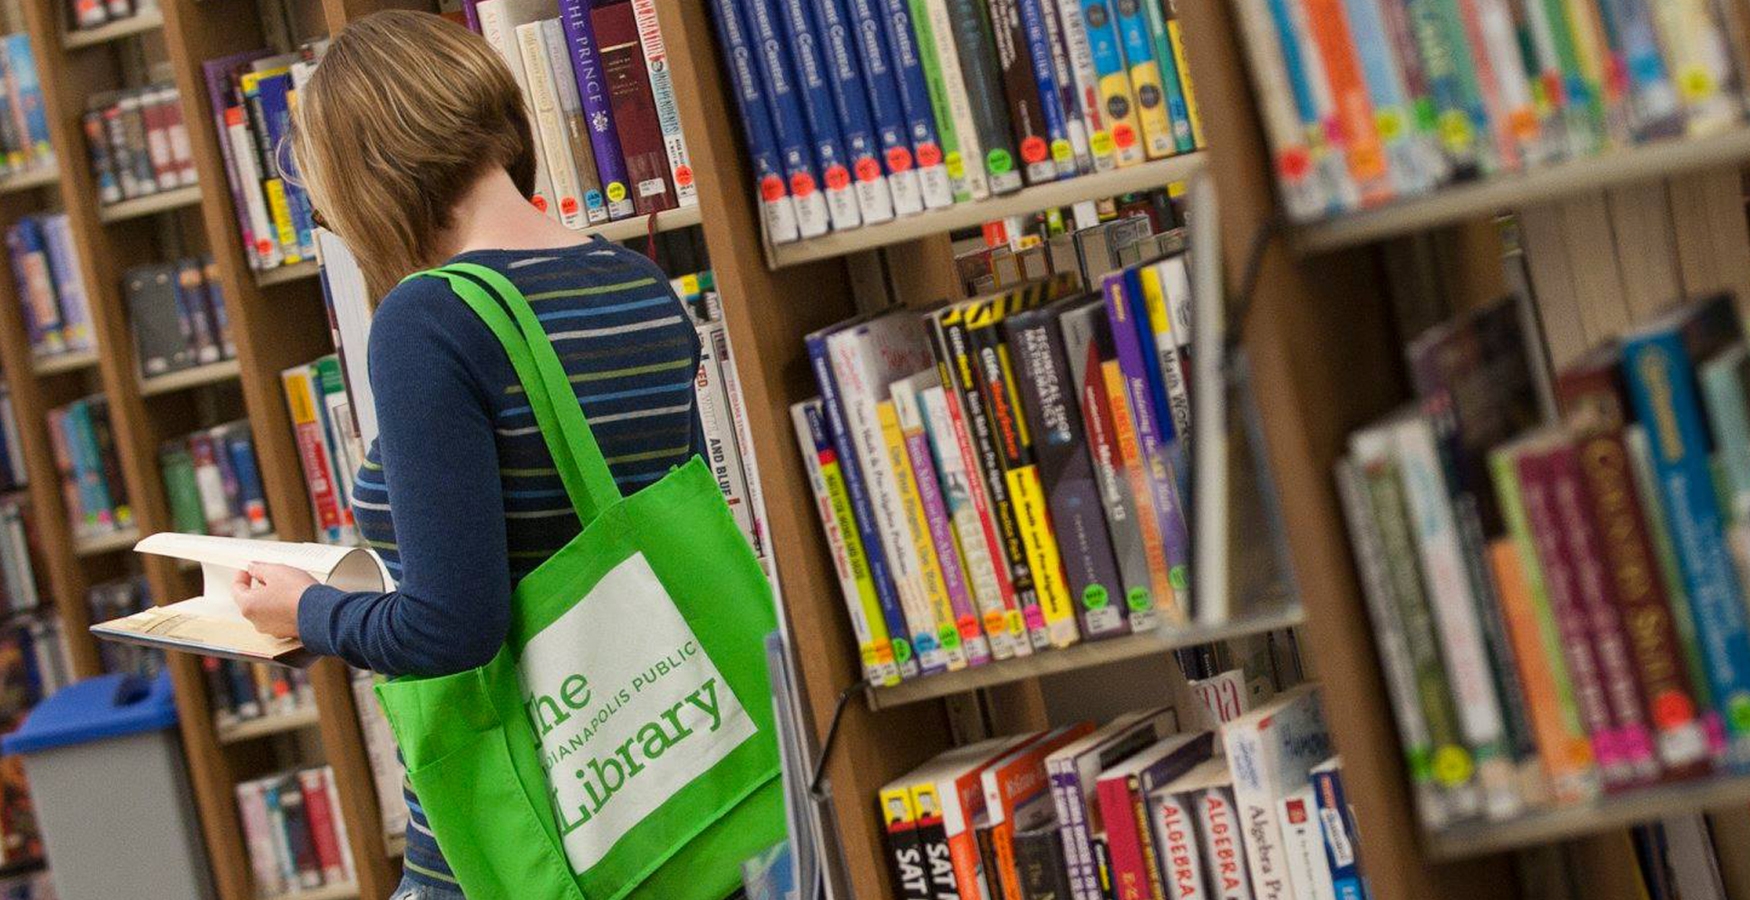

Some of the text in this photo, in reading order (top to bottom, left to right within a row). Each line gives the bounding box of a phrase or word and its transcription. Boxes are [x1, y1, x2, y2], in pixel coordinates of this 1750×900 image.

[566, 0, 602, 104] HE PRINCE
[764, 38, 789, 95] Central
[796, 32, 823, 87] Central
[828, 24, 854, 80] Central
[861, 18, 886, 74] Central
[893, 11, 917, 68] Central
[733, 45, 758, 101] Central
[587, 193, 600, 201] JAN
[1024, 330, 1057, 428] MATHEMATICS
[1035, 325, 1072, 442] TECHNICAL SHOP
[1161, 349, 1180, 387] Math
[709, 439, 724, 462] AND
[717, 467, 732, 496] BLUE
[863, 427, 877, 454] Math
[870, 455, 881, 466] &
[872, 468, 896, 529] Pre-Algebra
[917, 466, 935, 500] Math
[983, 451, 1006, 502] Pre-Algebra
[1022, 500, 1036, 527] Math
[1031, 530, 1042, 550] and
[1110, 502, 1127, 522] 13
[890, 529, 909, 577] Problems
[1033, 552, 1061, 613] Pre-Algebra
[529, 674, 592, 737] he
[545, 641, 698, 770] DIANAPOLIS PUBLIC
[551, 677, 723, 836] Library
[926, 843, 957, 889] SAT
[1162, 804, 1196, 898] ALGEBRA
[1207, 797, 1241, 890] ALGEBRA
[1249, 804, 1273, 876] Algebra
[896, 848, 928, 893] SAT
